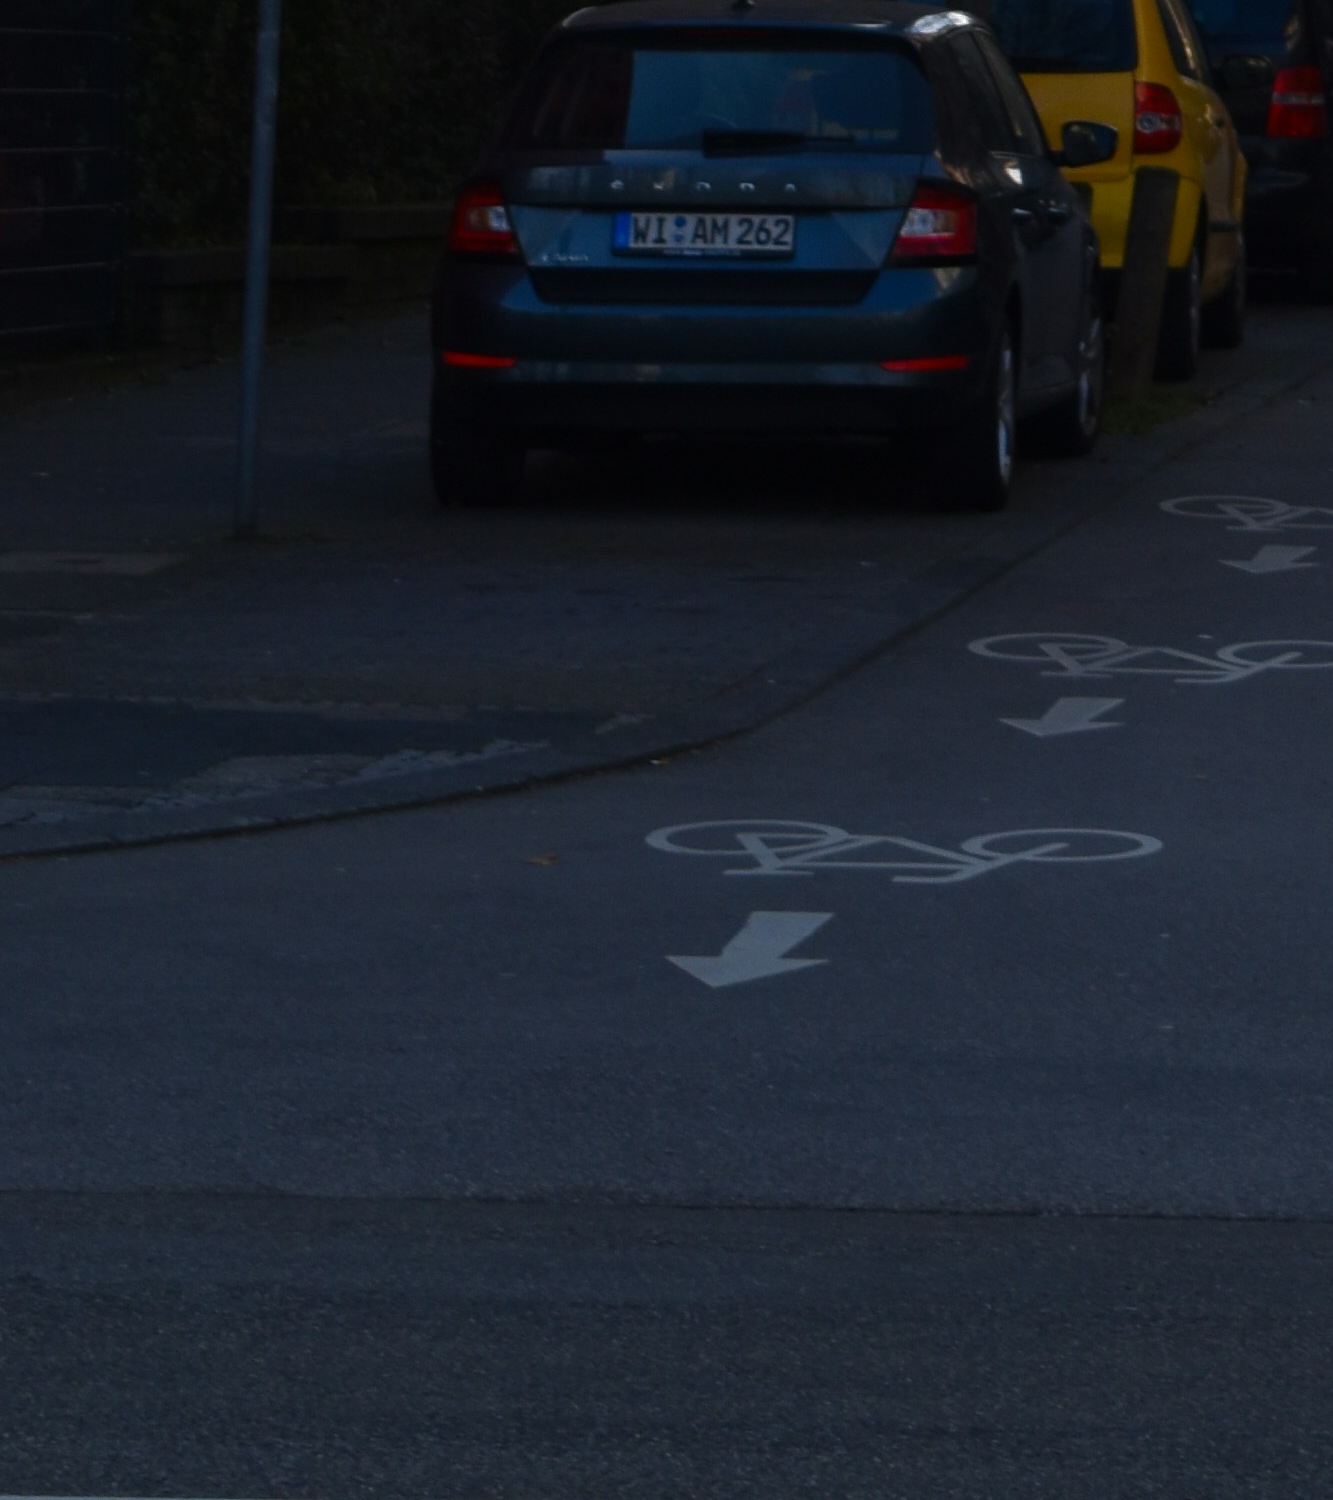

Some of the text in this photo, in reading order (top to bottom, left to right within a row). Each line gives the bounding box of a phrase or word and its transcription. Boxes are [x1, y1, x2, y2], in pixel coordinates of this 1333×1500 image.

[632, 216, 792, 247] WI AM 262
